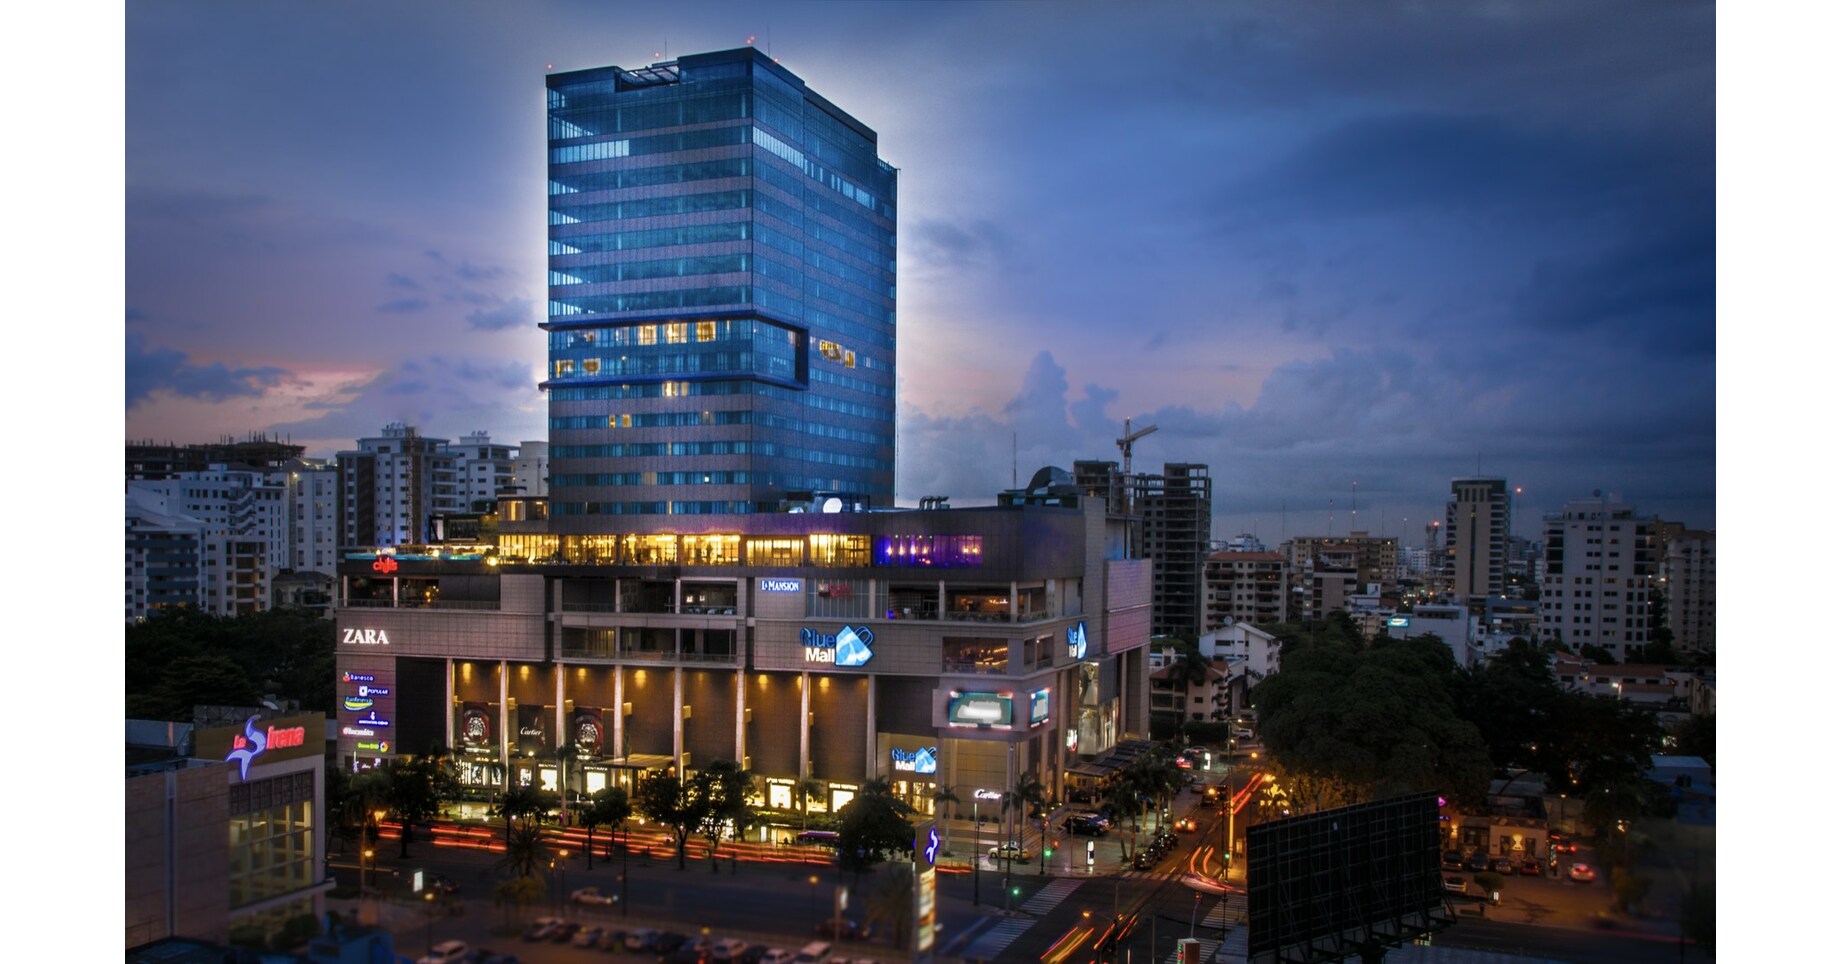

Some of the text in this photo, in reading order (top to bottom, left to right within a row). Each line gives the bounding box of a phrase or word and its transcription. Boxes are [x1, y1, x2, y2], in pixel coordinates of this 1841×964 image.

[768, 580, 799, 591] MANSION
[343, 628, 389, 645] ZARA
[800, 627, 836, 647] Blue
[805, 647, 835, 663] Mall
[520, 726, 542, 736] Cartier
[892, 748, 916, 761] Blue
[895, 760, 915, 771] Mall
[974, 788, 1002, 800] Cartier
